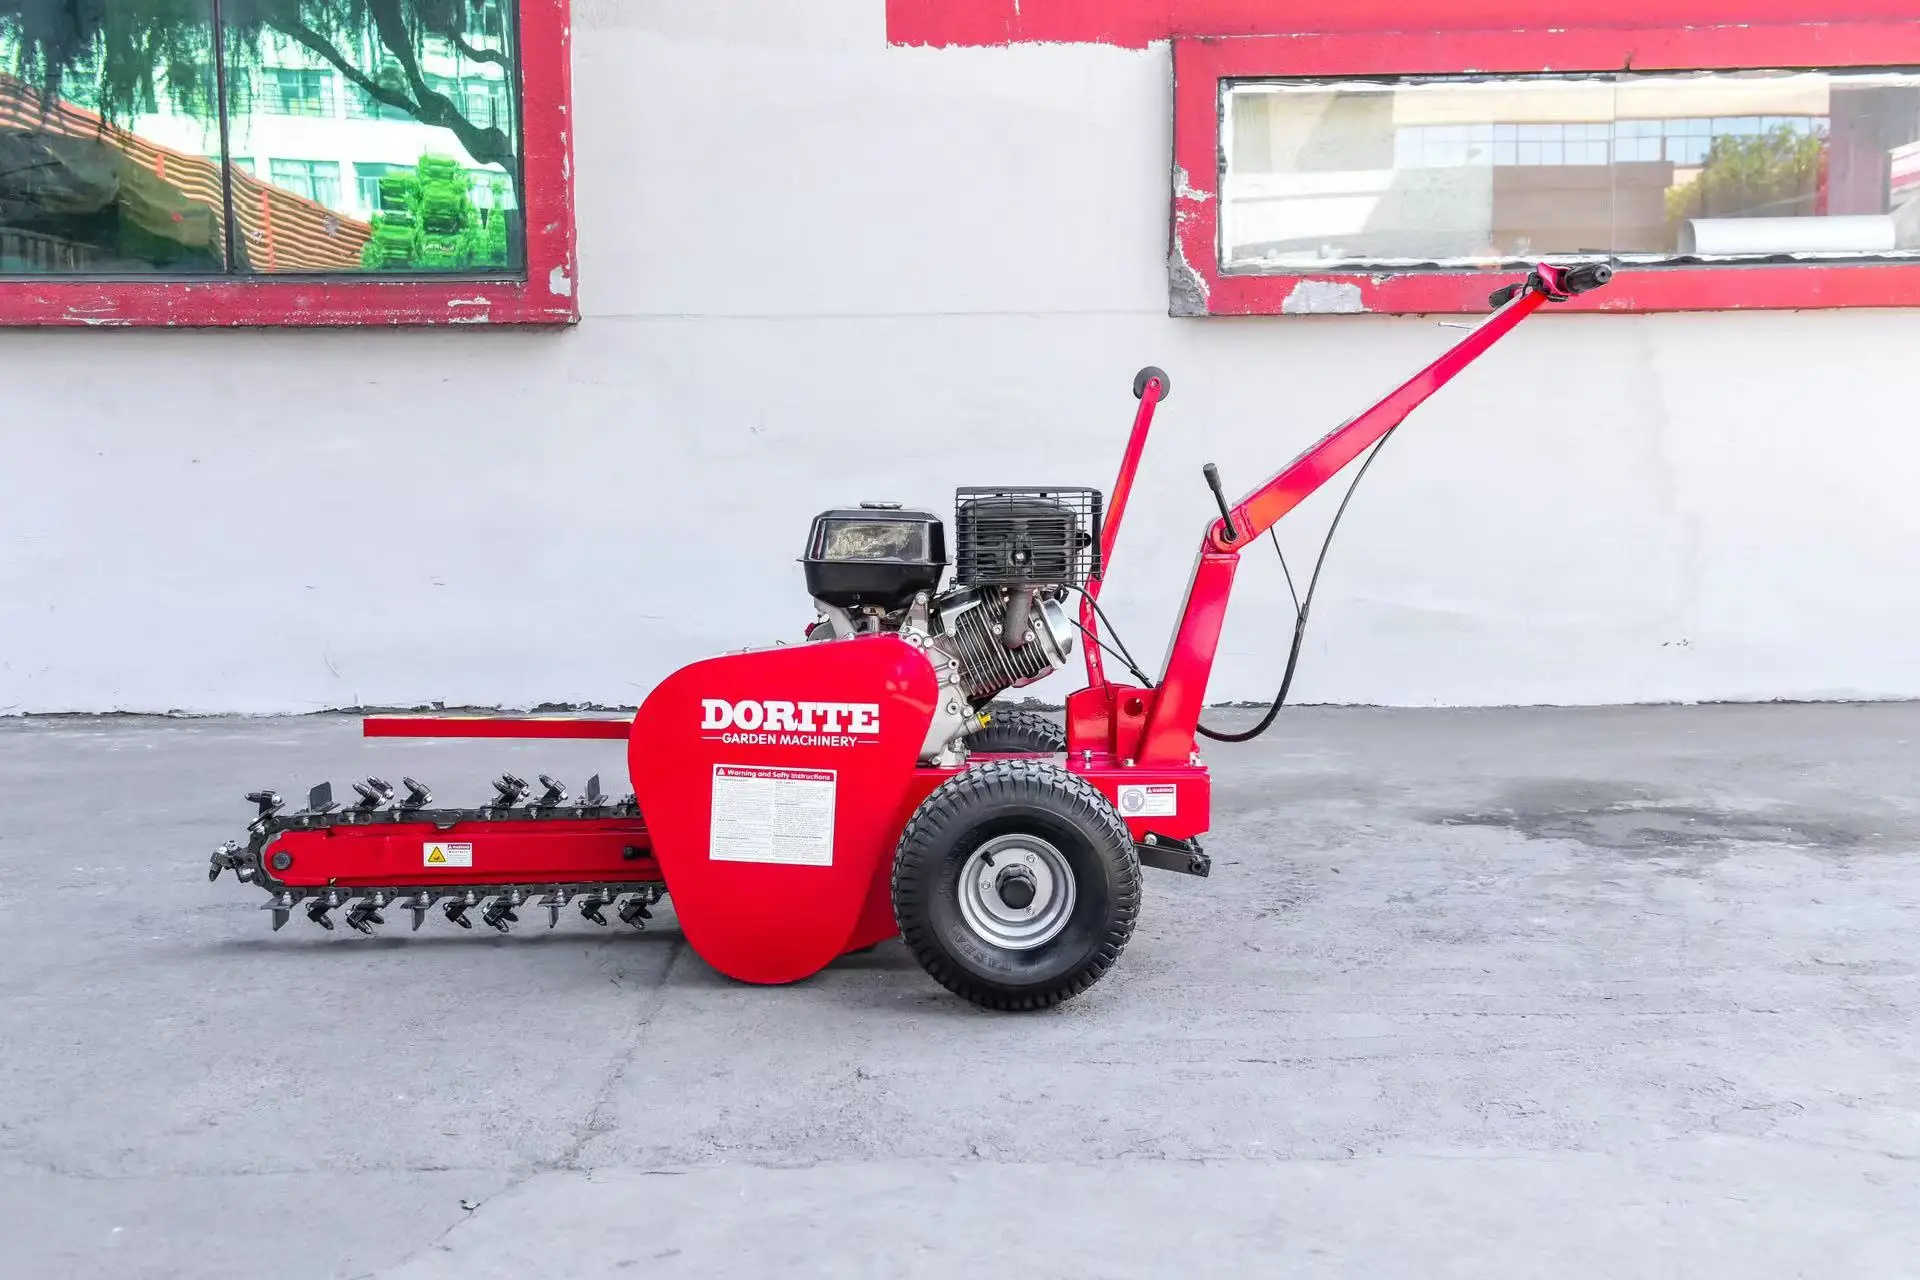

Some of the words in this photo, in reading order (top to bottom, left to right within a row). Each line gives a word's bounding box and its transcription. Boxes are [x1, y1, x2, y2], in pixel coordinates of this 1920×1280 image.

[701, 698, 880, 734] DORITE
[721, 732, 777, 745] GARDEN
[779, 735, 858, 747] MACHINERY
[727, 769, 757, 778] Warning
[790, 773, 831, 781] Instructions
